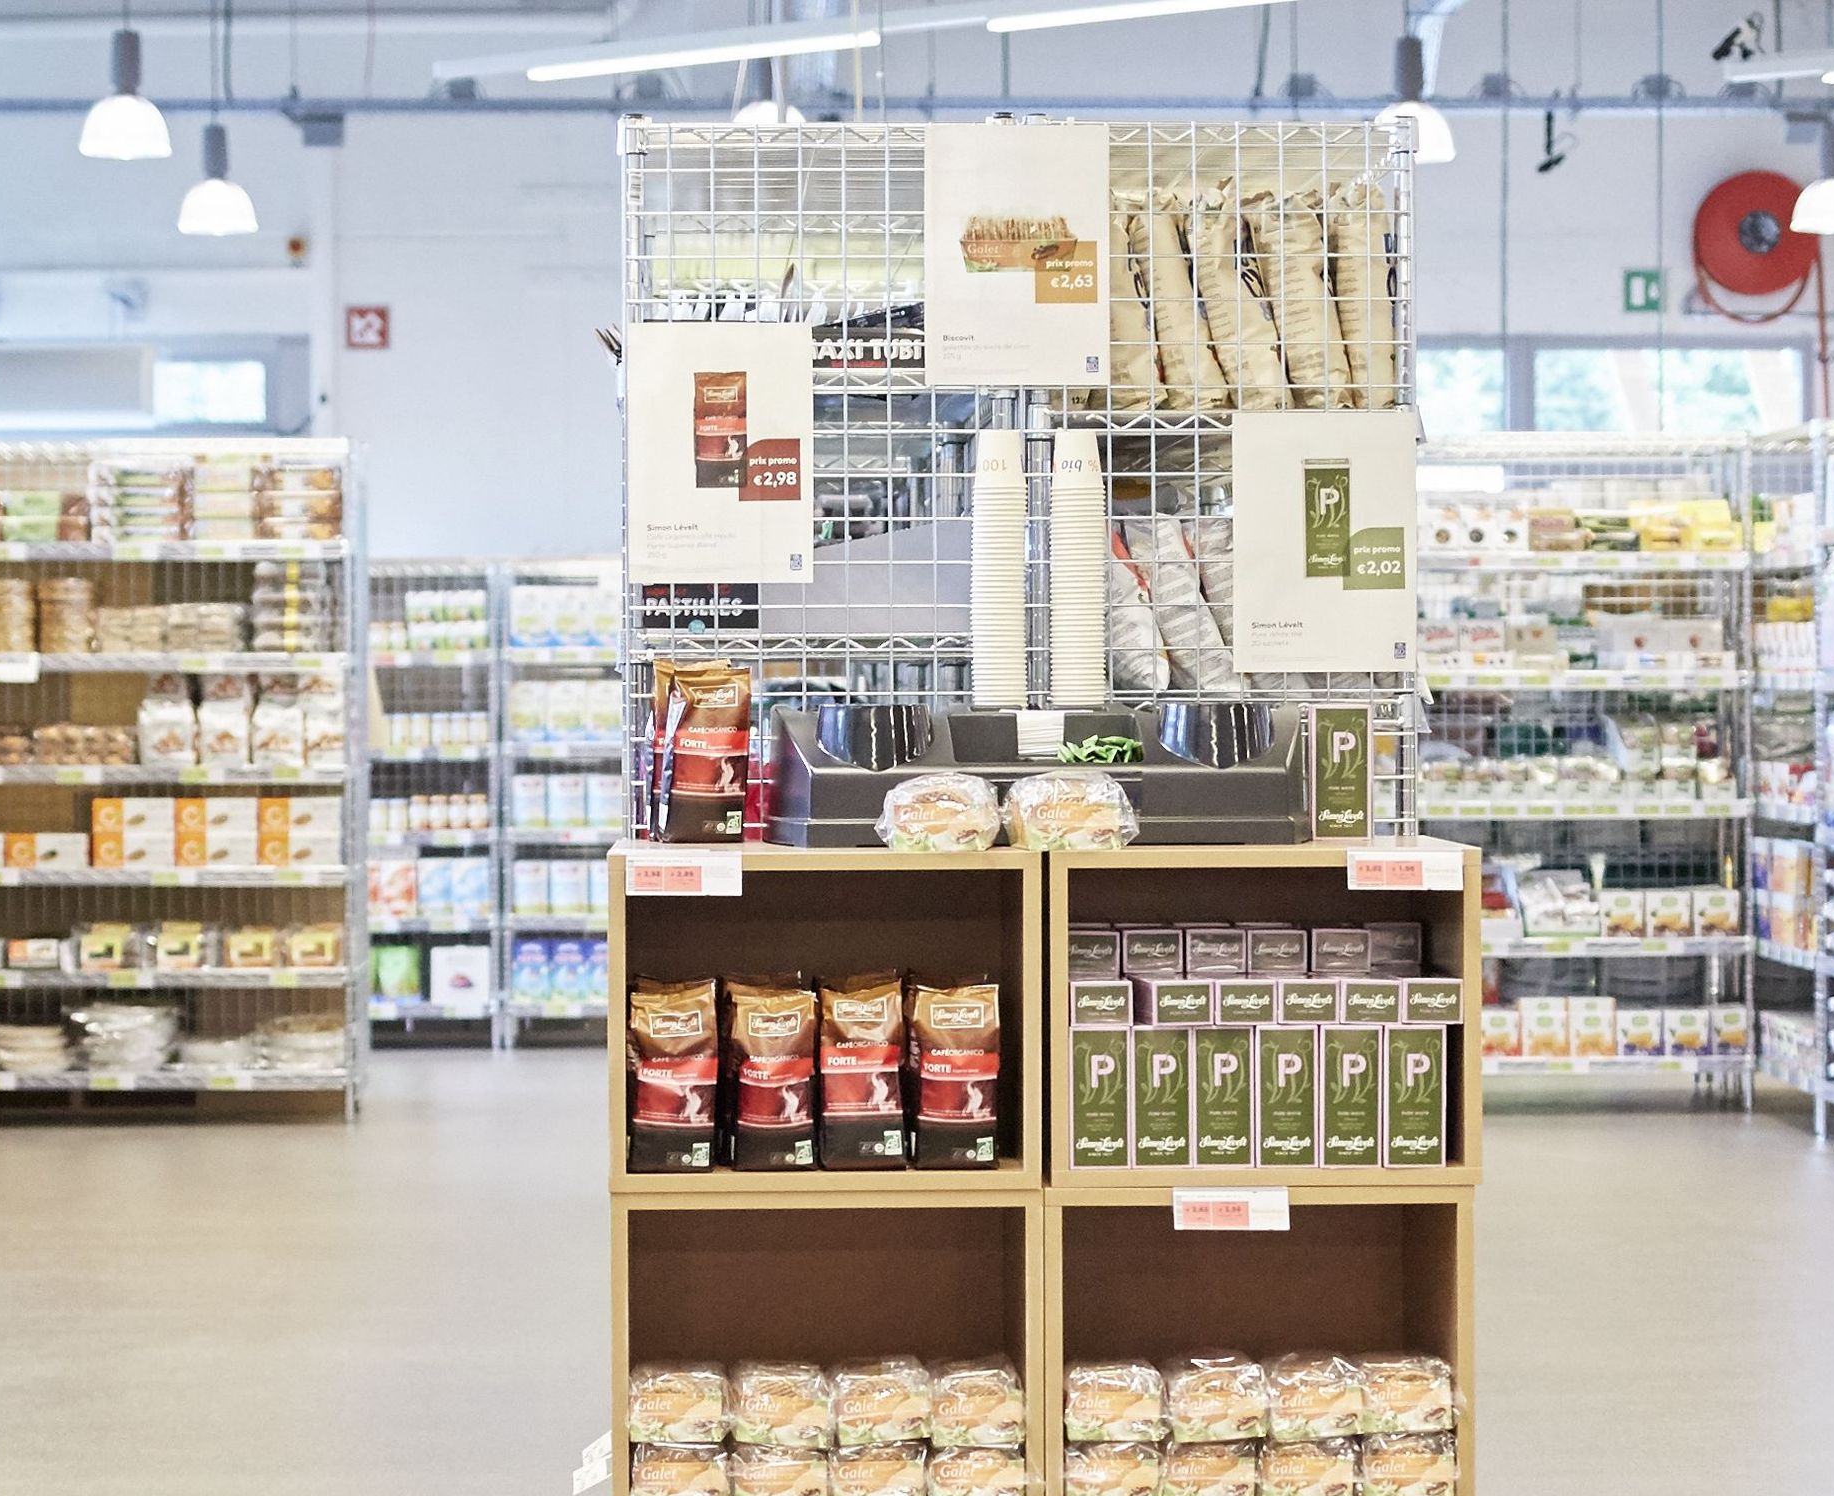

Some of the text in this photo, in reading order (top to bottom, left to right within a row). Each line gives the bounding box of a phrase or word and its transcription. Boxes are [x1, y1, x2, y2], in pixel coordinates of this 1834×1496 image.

[1046, 259, 1093, 269] prix promo
[869, 338, 922, 360] TUBI
[749, 457, 797, 466] prix promo
[1354, 545, 1400, 555] prix promo
[645, 597, 743, 616] PASTILLES
[1333, 731, 1356, 763] P
[1091, 1054, 1115, 1088] P
[1153, 1054, 1176, 1088] P
[1214, 1053, 1238, 1087] P
[1278, 1053, 1302, 1087] P
[1342, 1053, 1366, 1087] P
[1407, 1053, 1430, 1087] P
